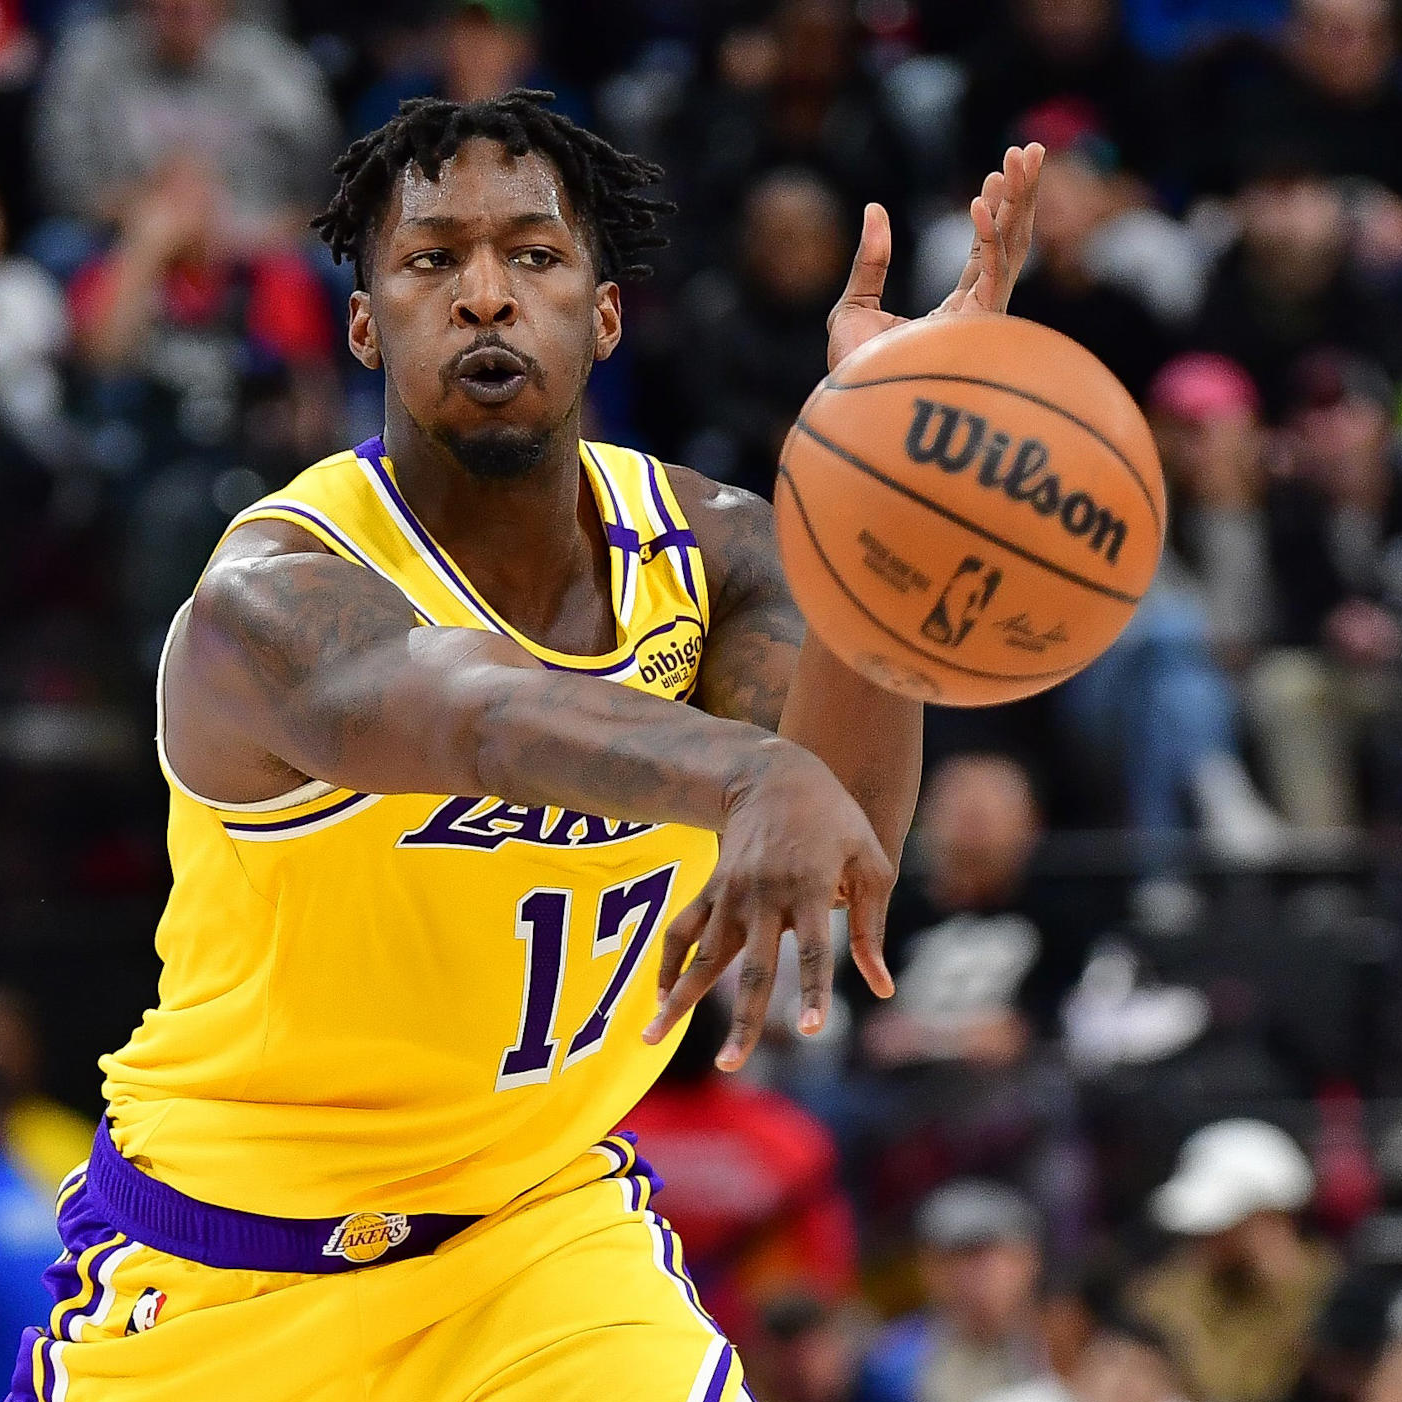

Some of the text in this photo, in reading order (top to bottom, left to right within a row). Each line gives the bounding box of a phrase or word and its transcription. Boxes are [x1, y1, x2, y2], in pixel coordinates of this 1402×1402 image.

[905, 398, 1129, 565] Wilson
[639, 636, 703, 684] bibigo
[494, 860, 681, 1092] 17
[325, 1222, 406, 1253] LAKERS
